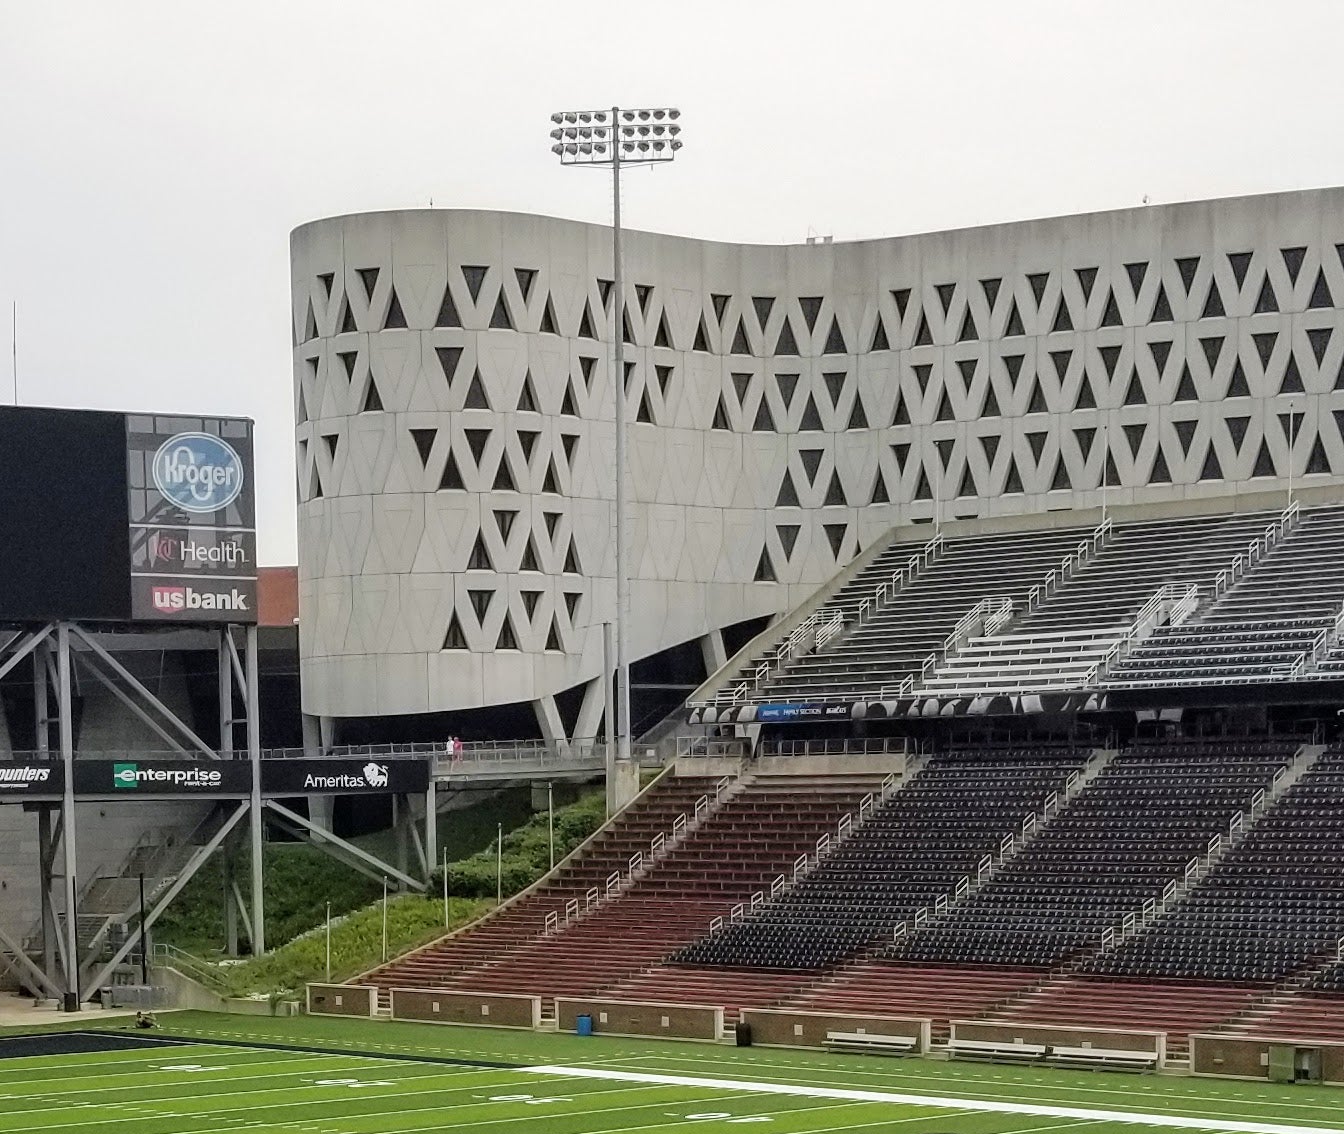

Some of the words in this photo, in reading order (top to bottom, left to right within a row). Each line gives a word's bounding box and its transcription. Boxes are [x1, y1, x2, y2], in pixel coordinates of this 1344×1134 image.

[164, 446, 234, 501] Kroger
[180, 541, 245, 563] Health
[154, 587, 249, 610] usbank
[118, 767, 222, 785] enterprise
[303, 773, 365, 788] Ameritas
